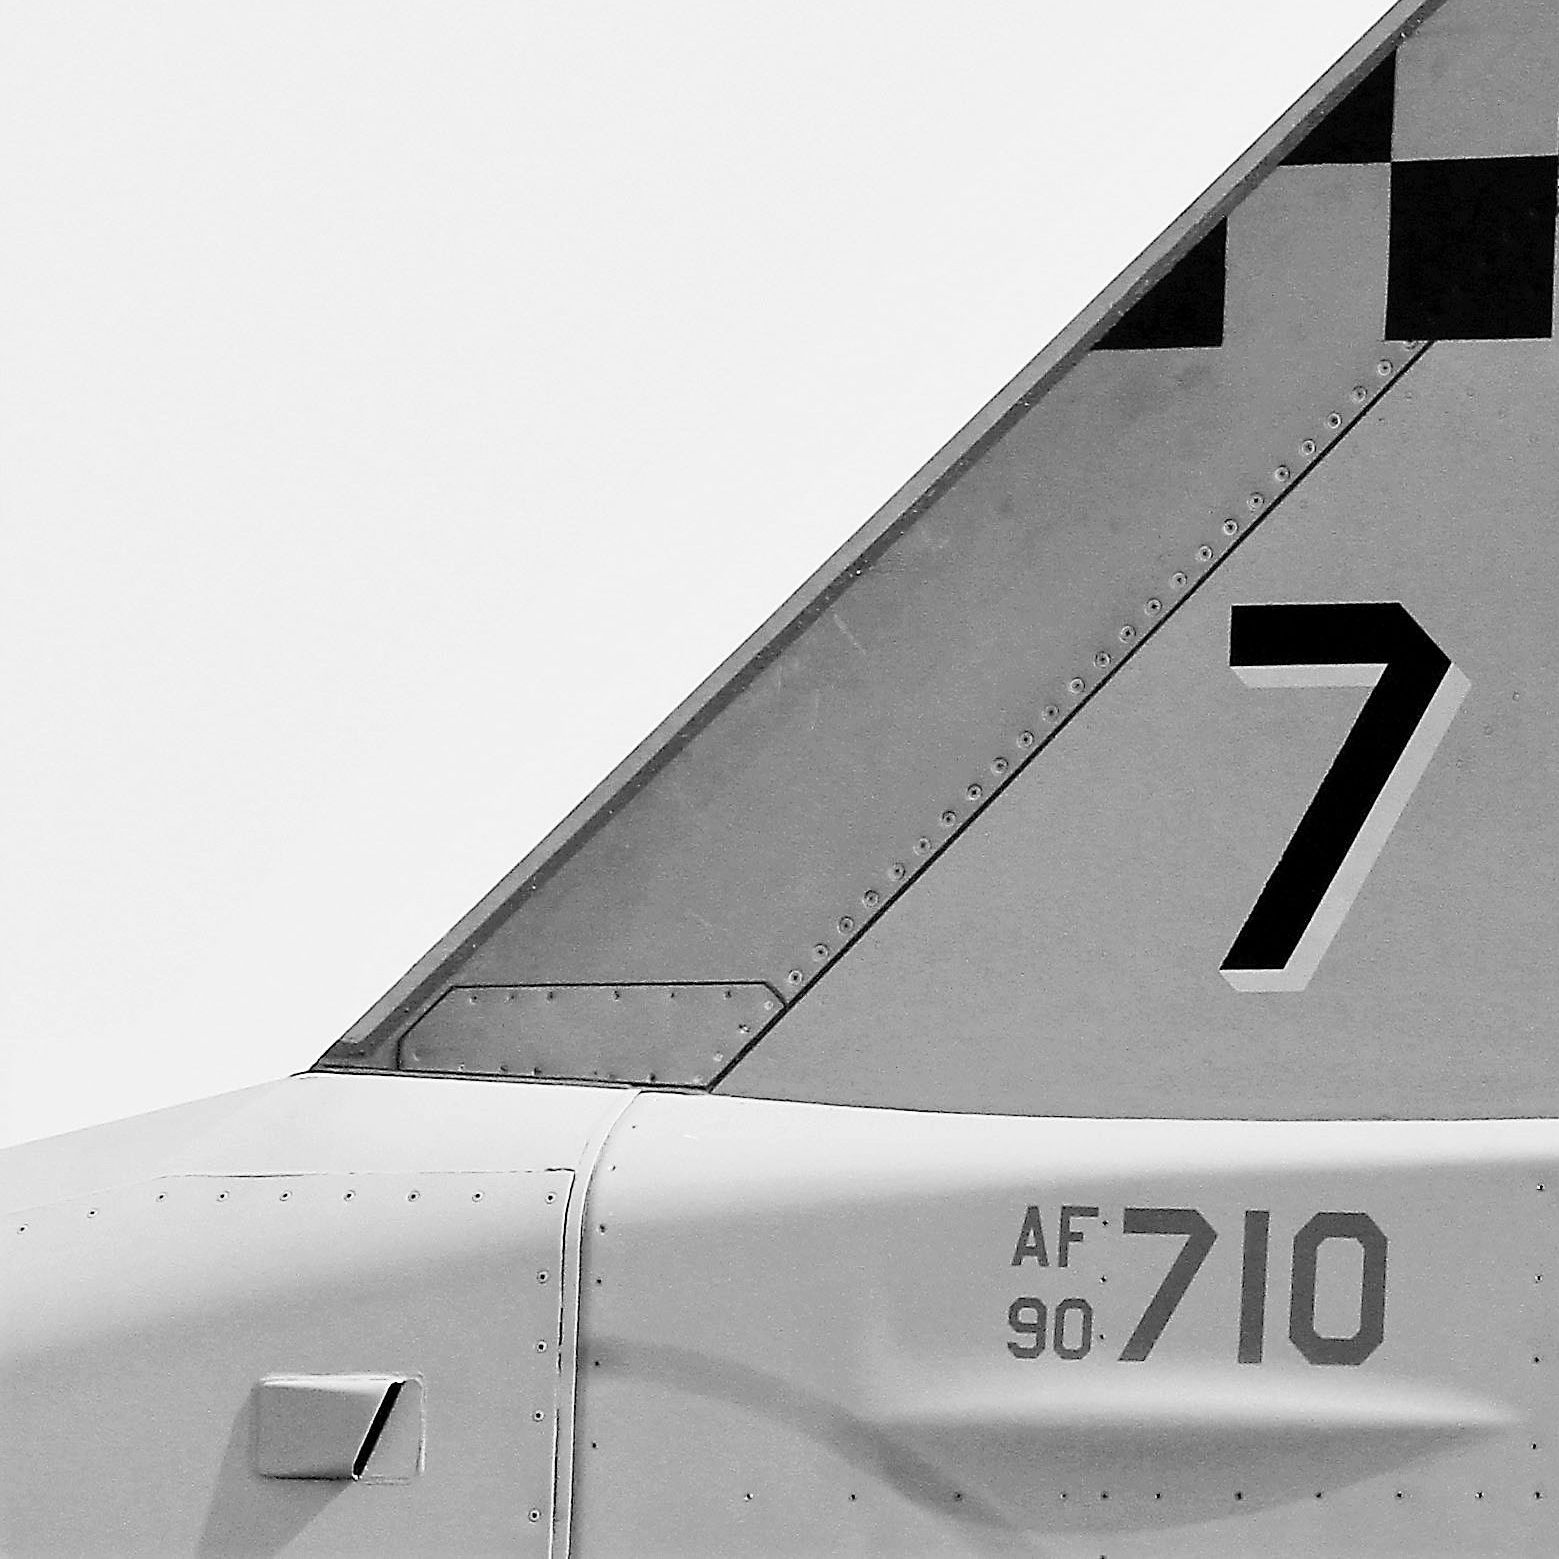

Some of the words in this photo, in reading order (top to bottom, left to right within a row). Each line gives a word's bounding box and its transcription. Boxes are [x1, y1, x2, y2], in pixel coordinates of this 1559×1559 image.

[1219, 602, 1471, 992] 7
[1011, 1205, 1099, 1268] AF
[1117, 1208, 1388, 1365] 710
[1007, 1297, 1093, 1360] 90
